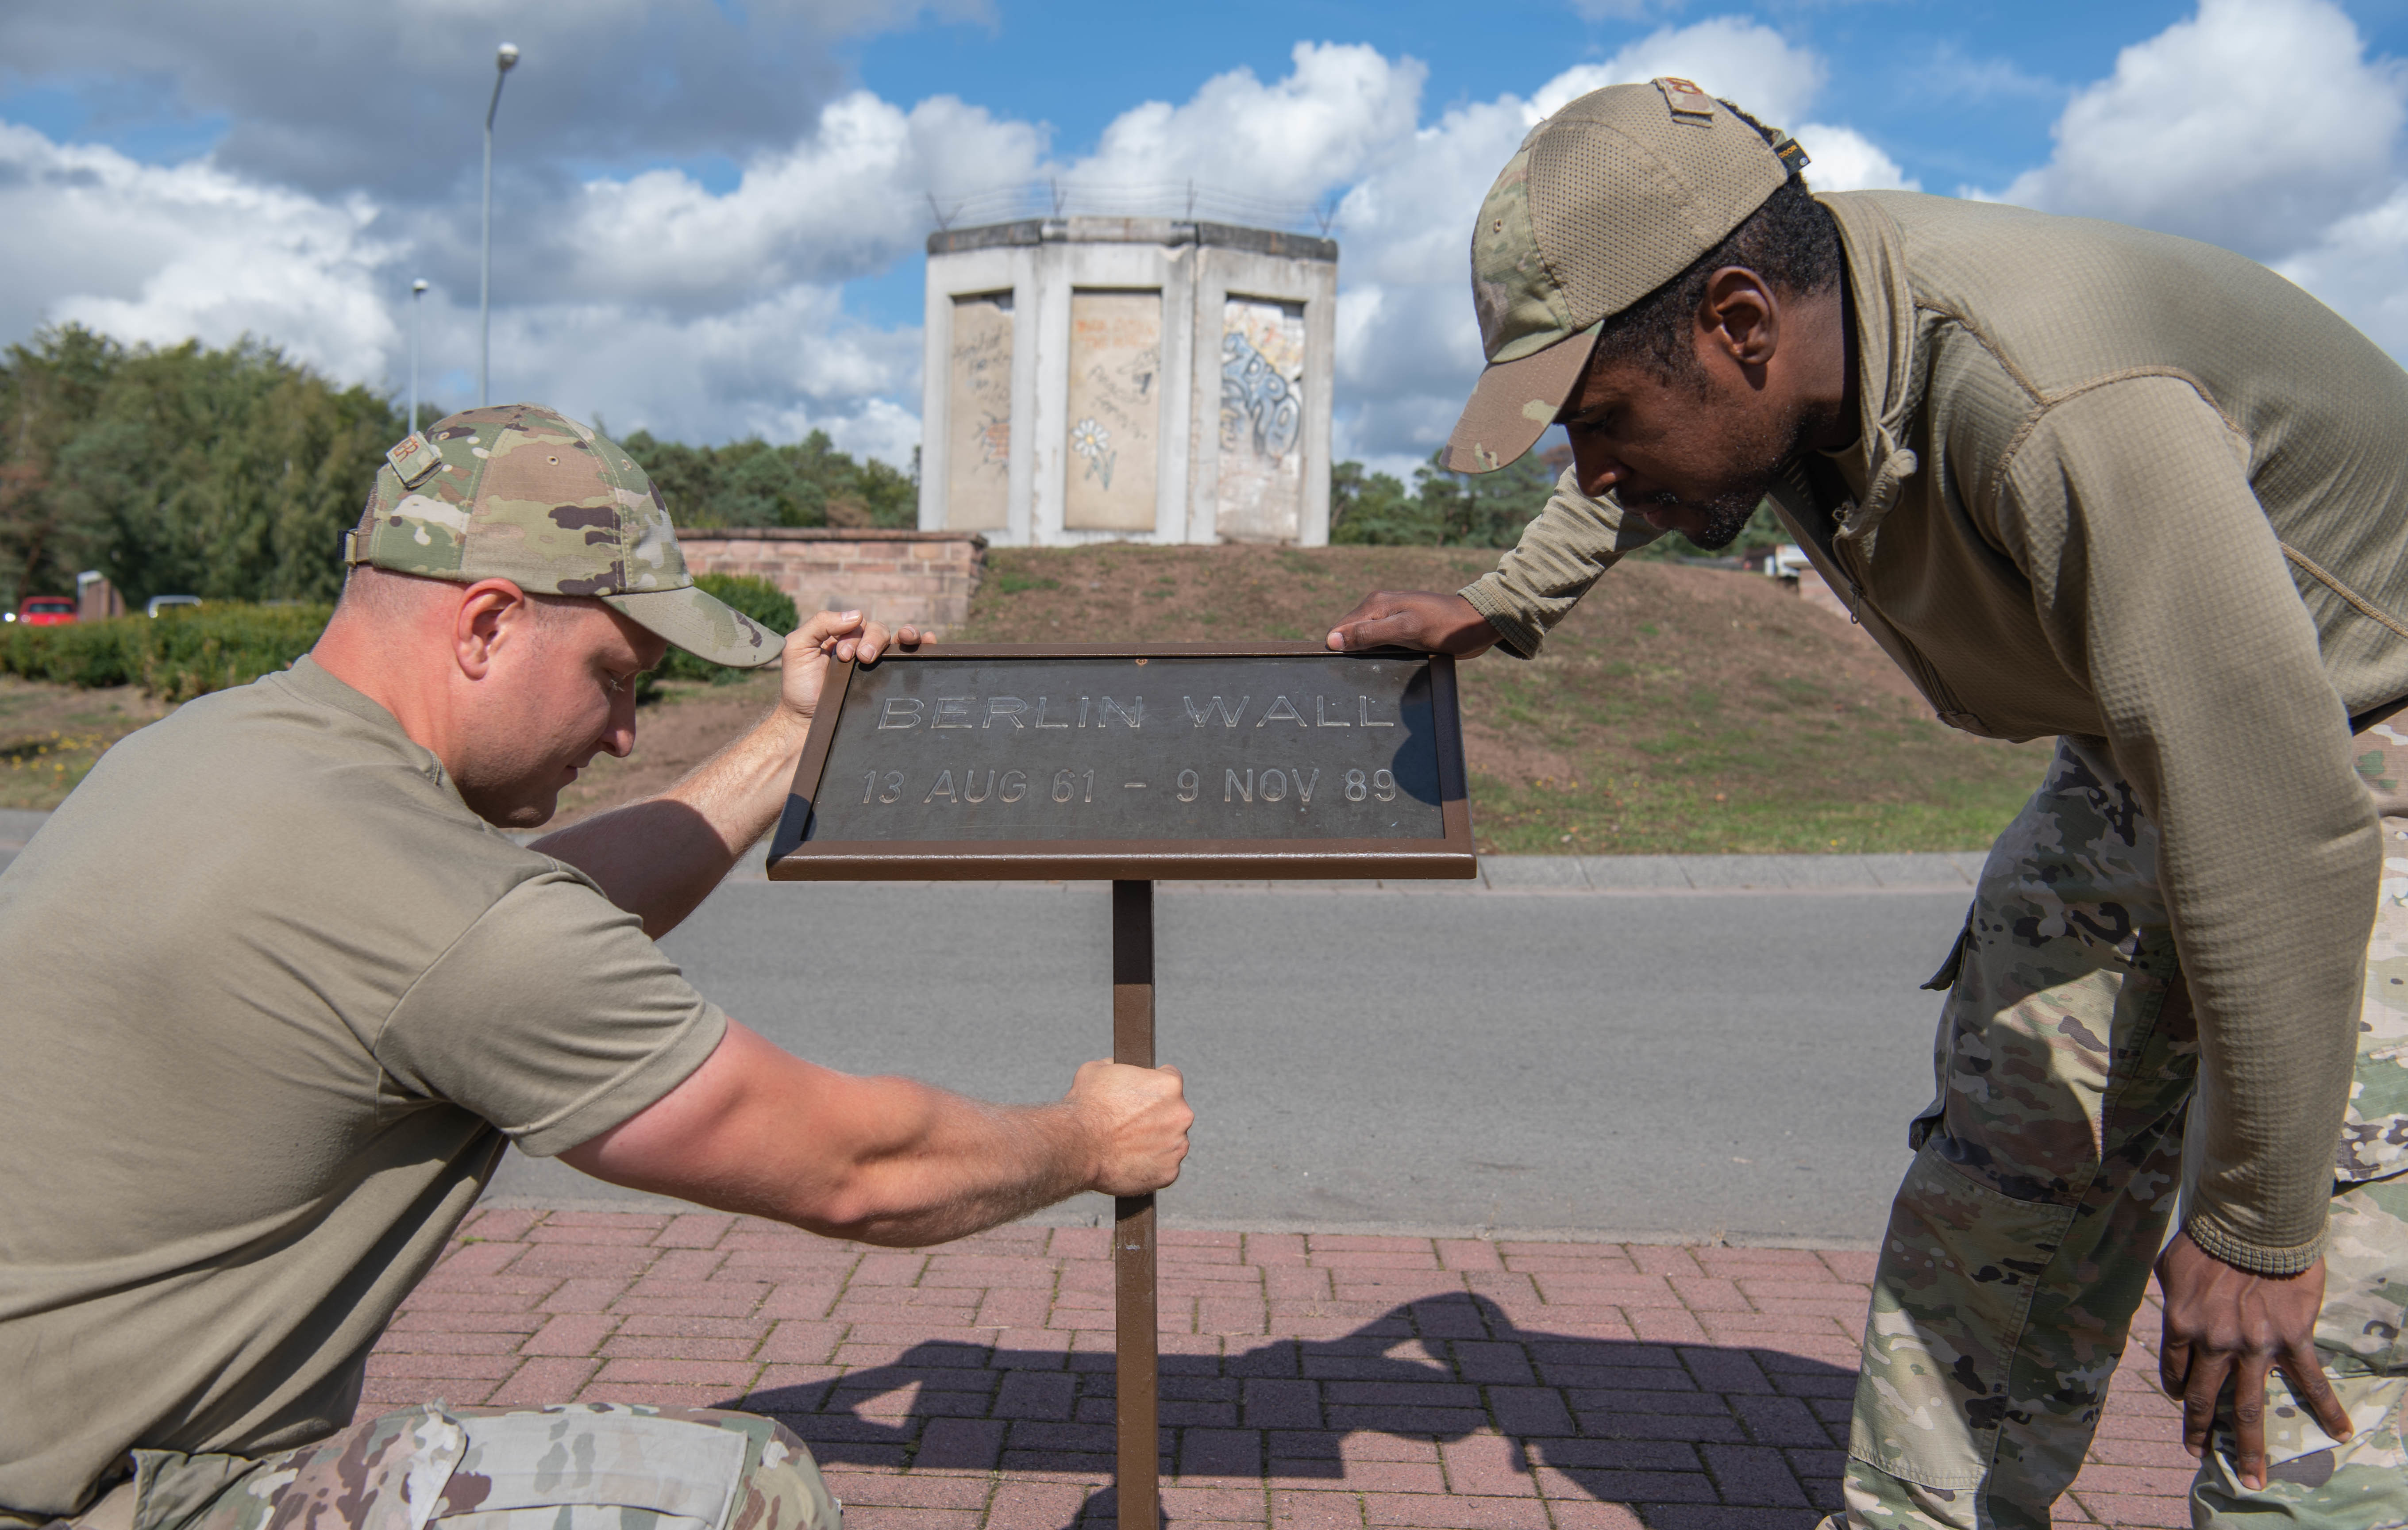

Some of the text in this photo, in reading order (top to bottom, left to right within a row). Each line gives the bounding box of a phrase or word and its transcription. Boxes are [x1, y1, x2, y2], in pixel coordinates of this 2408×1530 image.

[878, 695, 1395, 729] BERLIN WALL
[863, 769, 905, 804] 13
[923, 769, 1027, 803] AUG
[1051, 769, 1095, 803] 61
[1176, 768, 1199, 802] 9
[1224, 768, 1320, 802] NOV
[1345, 768, 1396, 802] 89
